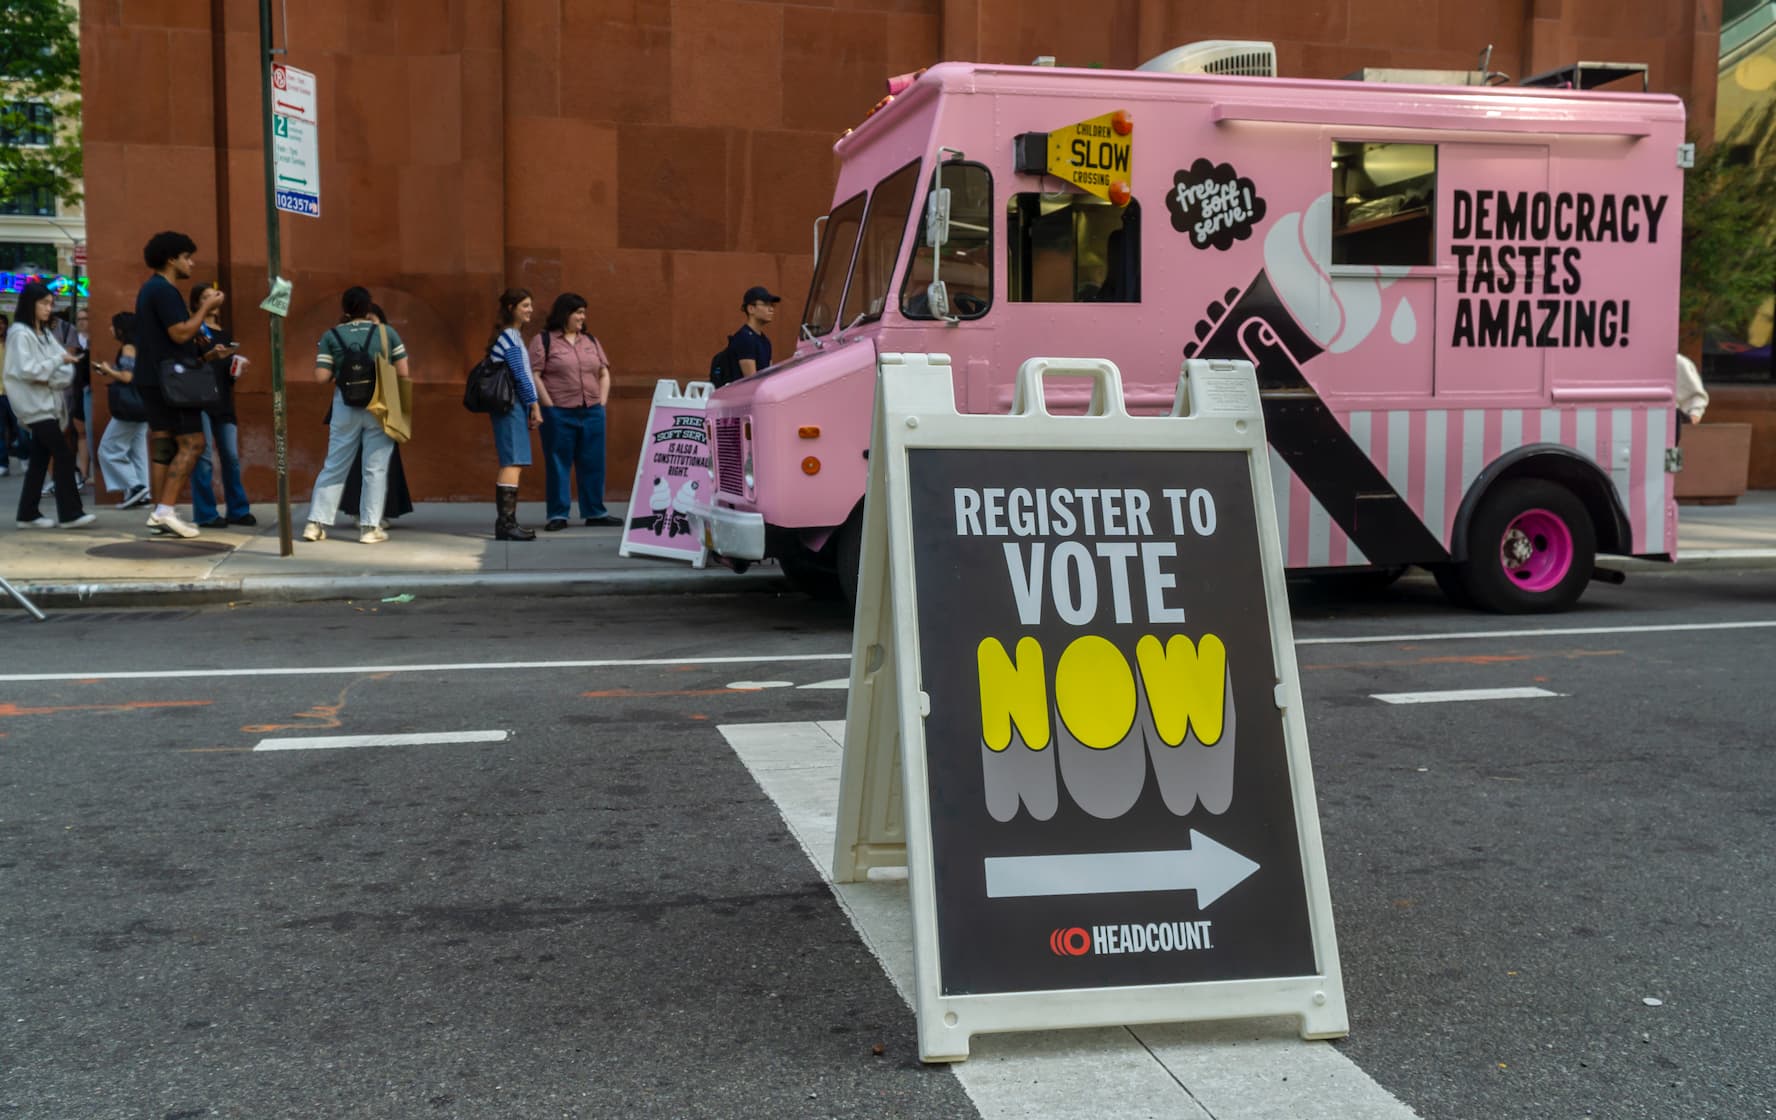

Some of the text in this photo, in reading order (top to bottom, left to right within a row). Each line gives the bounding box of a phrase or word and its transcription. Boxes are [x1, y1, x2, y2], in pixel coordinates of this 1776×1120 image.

[278, 116, 285, 136] 2
[1077, 123, 1112, 138] CHILDREN
[1071, 138, 1129, 172] SLOW
[1073, 171, 1111, 186] CROSSING
[1176, 178, 1220, 212] free
[1194, 187, 1254, 243] serve!
[1201, 180, 1240, 218] soft
[1453, 190, 1668, 243] DEMOCRACY
[1451, 245, 1581, 295] TASTES
[1452, 298, 1630, 348] AMAZING!
[656, 429, 706, 443] SOFT SERV
[675, 417, 703, 427] FREE
[668, 443, 698, 456] IS ALSO A
[954, 487, 1217, 537] REGISTER TO
[1003, 541, 1185, 626] VOTE
[977, 633, 1228, 753] NOW
